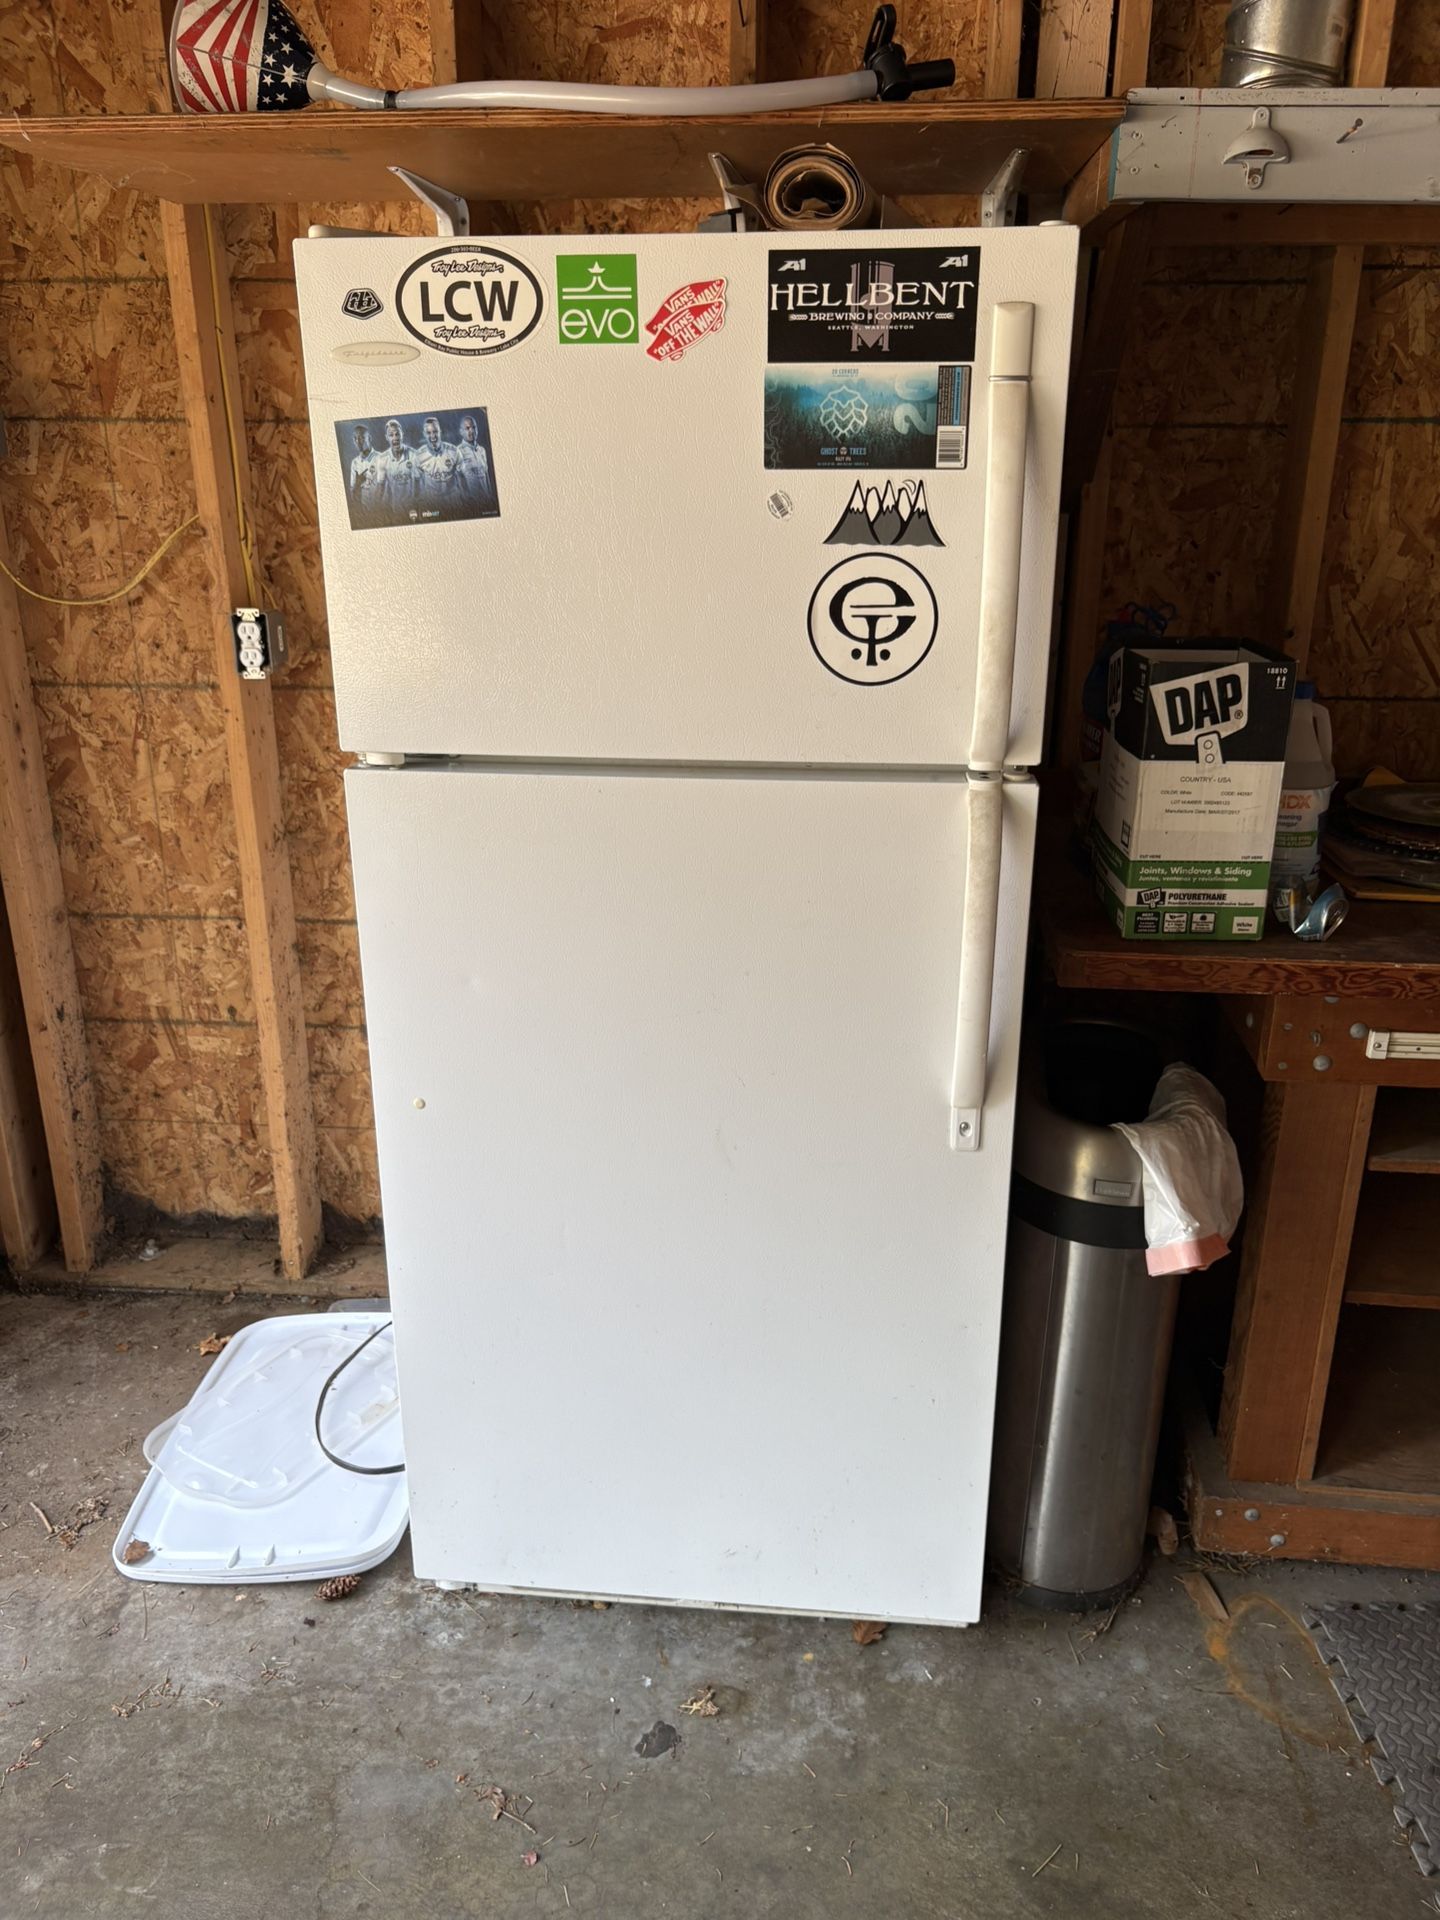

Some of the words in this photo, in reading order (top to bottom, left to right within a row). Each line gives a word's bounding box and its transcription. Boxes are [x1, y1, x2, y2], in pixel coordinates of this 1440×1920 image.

[431, 260, 449, 277] Troy
[449, 260, 466, 274] Lee
[466, 259, 504, 277] Designs
[420, 280, 519, 322] LCW
[664, 286, 695, 313] VANS
[770, 281, 975, 310] HELLBENT
[561, 308, 635, 339] evo
[664, 309, 695, 336] VANS
[808, 312, 865, 321] BREWING
[875, 311, 935, 321] COMPANY
[434, 326, 452, 342] Troy
[452, 326, 469, 338] Lee
[468, 325, 506, 342] Designs
[674, 324, 699, 346] THE
[1139, 866, 1167, 875] Joints,
[1170, 866, 1212, 874] Windows
[1224, 866, 1252, 877] Siding
[1144, 891, 1160, 902] DAP
[1168, 893, 1227, 901] POLYURETHANE
